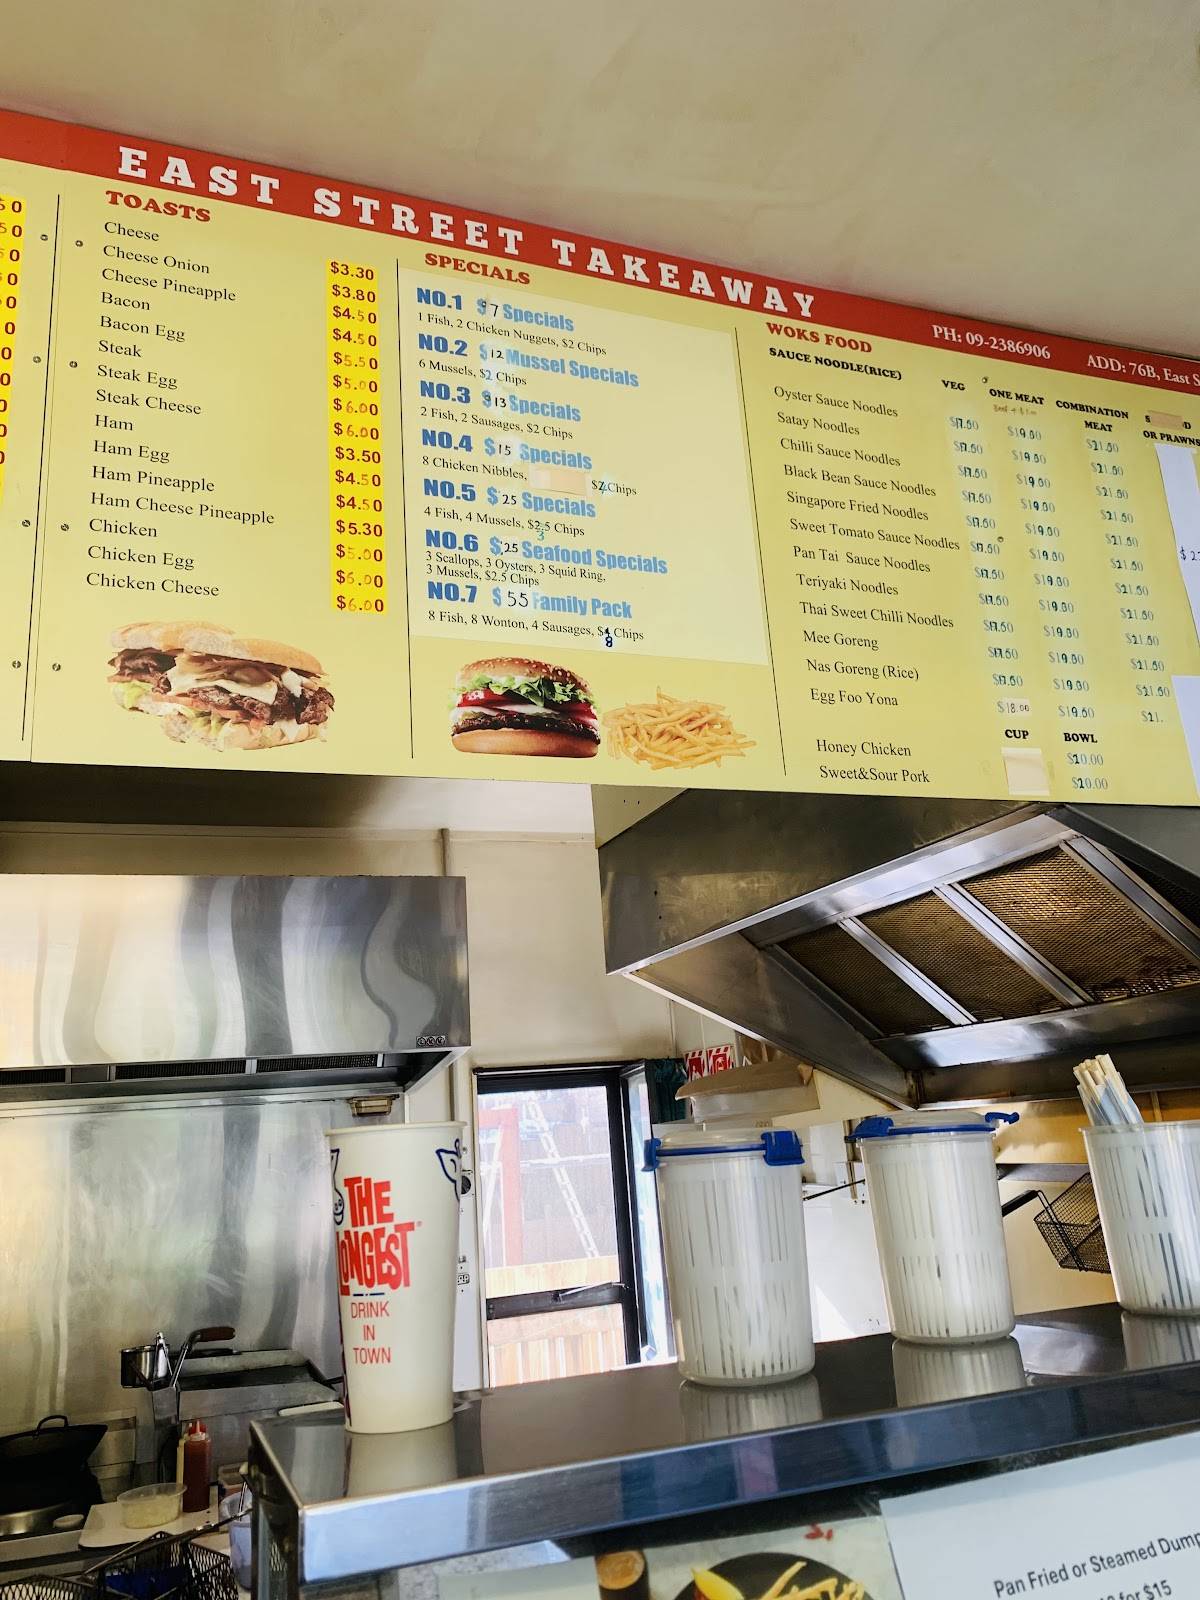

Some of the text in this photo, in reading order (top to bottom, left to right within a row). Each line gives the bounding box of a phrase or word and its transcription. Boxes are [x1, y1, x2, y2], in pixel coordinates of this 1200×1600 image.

[105, 190, 211, 222] TOASTS
[104, 222, 159, 242] Cheese
[118, 146, 816, 318] EAST STREET TAKEAWAY
[103, 245, 209, 274] Cheese Onion
[330, 262, 374, 280] $3.30
[424, 253, 530, 284] SPECIALS
[102, 268, 236, 301] Cheese Pineapple
[332, 284, 376, 303] $3.80
[102, 292, 150, 311] Bacon
[417, 288, 462, 310] NO.1
[503, 304, 575, 332] Specials
[101, 315, 185, 343] Bacon Egg
[419, 312, 607, 356] 1 Fish, 2 Chicken Nuggets, $2 Chips
[766, 322, 872, 353] WOKS FOOD
[99, 340, 141, 358] Steak
[932, 325, 1051, 360] PH: 09-2386906
[419, 333, 468, 356] NO.2
[506, 348, 565, 373] Mussel
[569, 360, 640, 387] Specials
[769, 347, 902, 381] SAUCE NOODLE(RICE)
[1087, 355, 1126, 373] ADD:
[1129, 362, 1161, 381] 76B,
[1163, 368, 1190, 385] East
[98, 365, 178, 390] Steak Egg
[942, 380, 966, 391] VEG
[96, 389, 201, 415] Steak Cheese
[420, 380, 471, 404] NO.3
[509, 395, 581, 422] Specials
[774, 386, 898, 417] Oyster Sauce Noodles
[989, 388, 1045, 405] ONE MEAT
[1056, 400, 1129, 419] COMBINATION
[96, 414, 133, 431] Ham
[421, 406, 573, 441] 2 Fish, 2 Sausages, $2 Chips
[777, 412, 860, 435] Satay Noodles
[1084, 420, 1113, 432] MEAT
[422, 428, 473, 452] NO.4
[520, 443, 592, 470] Specials
[1143, 430, 1200, 447] OR PRAWNS
[94, 440, 170, 464] Ham Egg
[335, 446, 381, 464] $3.50
[780, 438, 901, 466] Chilli Sauce Noodles
[93, 466, 215, 493] Ham Pineapple
[784, 464, 936, 496] Black Bean Sauce Noodles
[92, 492, 274, 525] Ham Cheese Pineapple
[424, 479, 476, 502] NO.5
[522, 492, 596, 518] Specials
[787, 491, 929, 521] Singapore Fried Noodles
[89, 519, 157, 537] Chicken
[336, 520, 383, 537] $5.30
[88, 546, 194, 571] Chicken Egg
[425, 530, 479, 551] NO.6
[522, 541, 592, 566] Seafood
[596, 550, 668, 574] Specials
[426, 550, 606, 583] 3 Scallops, 3 Oysters, 3 Squid Ring,
[427, 564, 539, 588] 3 Mussels, $2.5 Chips
[86, 573, 219, 597] Chicken Cheese
[796, 573, 899, 595] Teriyaki Noodles
[428, 581, 477, 603] NO.7
[532, 592, 587, 616] Family
[591, 598, 632, 619] Pack
[799, 601, 954, 628] Thai Sweet Chilli Noodles
[806, 659, 919, 680] Nas Goreng (Rice)
[811, 688, 898, 706] Egg Foo Yona
[817, 739, 911, 757] Honey Chicken
[1005, 729, 1098, 744] CUP BOWL
[819, 765, 930, 783] Sweet&Sour Pork
[344, 1176, 394, 1227] THE
[336, 1222, 415, 1296] LONGEST
[351, 1301, 390, 1318] DRINK
[364, 1325, 375, 1340] IN
[353, 1348, 391, 1364] TOWN
[994, 1579, 1026, 1598] Pan
[1027, 1564, 1069, 1589] Fried
[1072, 1562, 1088, 1577] or
[1090, 1541, 1158, 1573] Steamed
